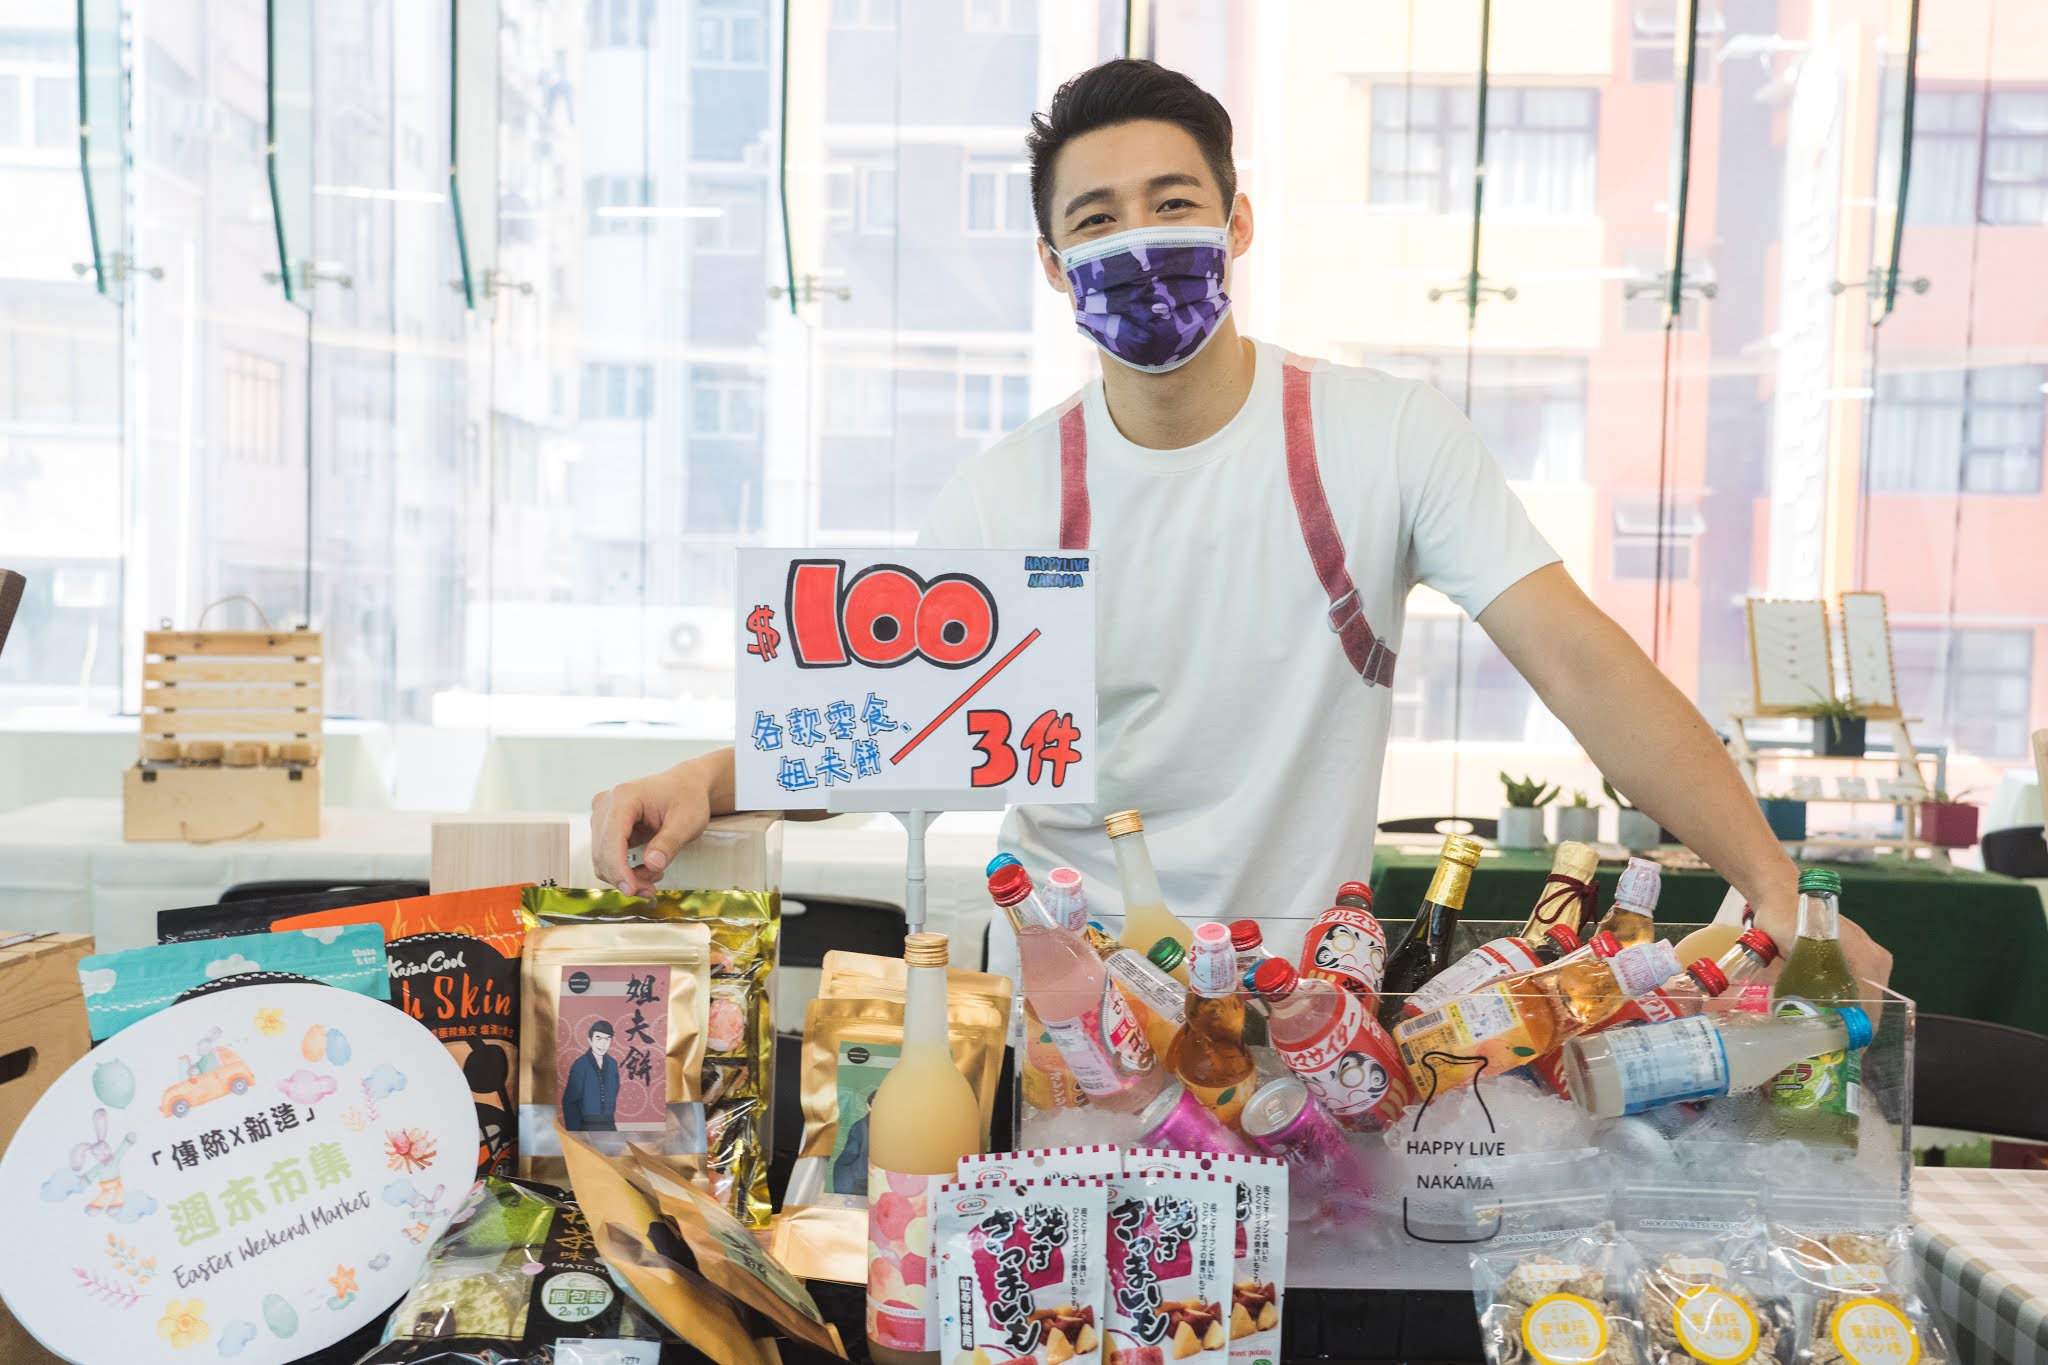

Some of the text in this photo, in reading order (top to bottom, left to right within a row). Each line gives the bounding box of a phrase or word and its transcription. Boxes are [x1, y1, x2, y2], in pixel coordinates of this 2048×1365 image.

[1028, 573, 1083, 588] NAKAMA
[777, 739, 881, 791] 姐夫餅
[433, 972, 511, 1019] Skin
[620, 973, 660, 1086] 姐夫餅
[1407, 1141, 1505, 1156] HAPPY LIVE
[1417, 1175, 1494, 1190] NAKAMA
[172, 1191, 370, 1288] Easter Weekend Market
